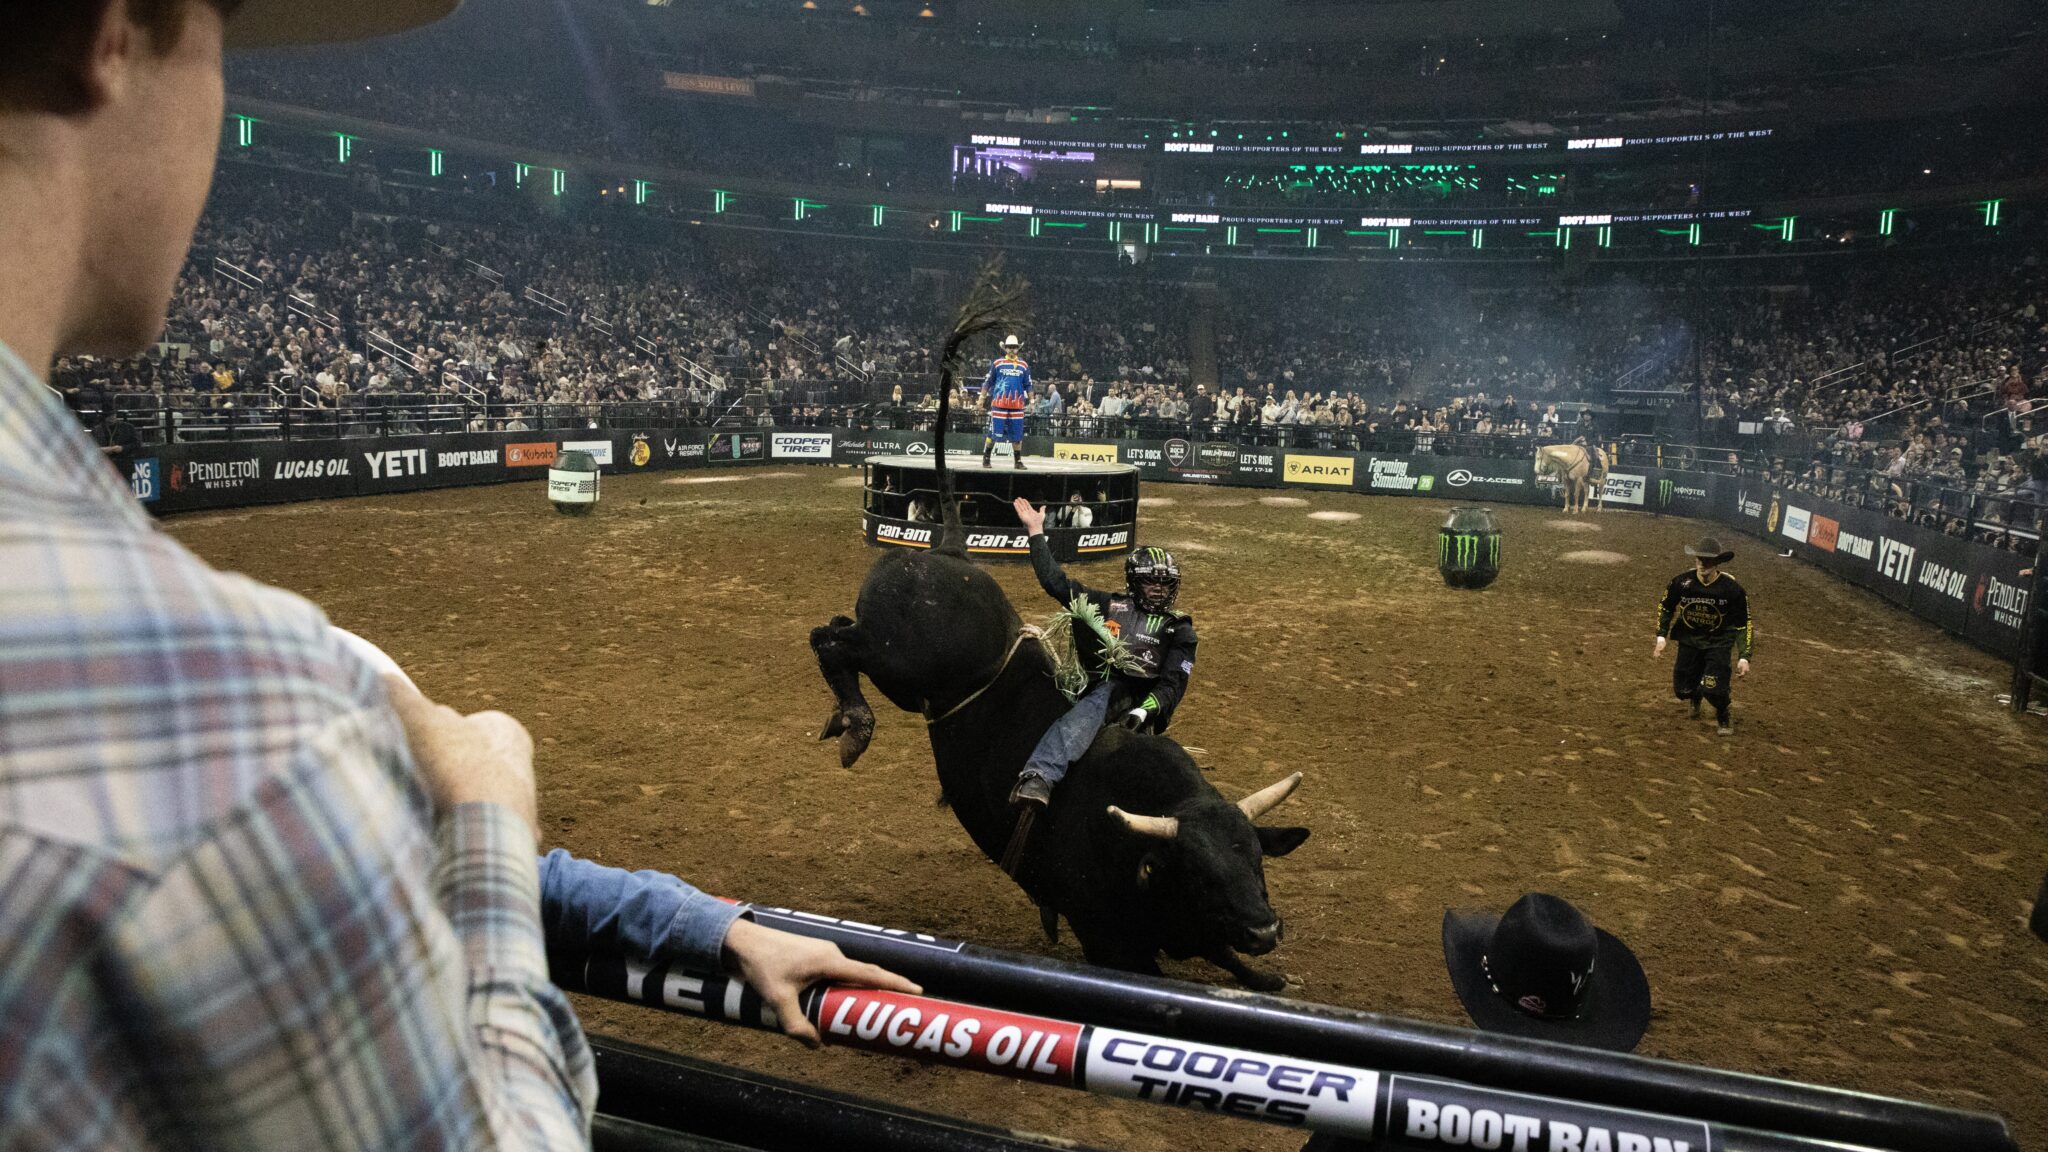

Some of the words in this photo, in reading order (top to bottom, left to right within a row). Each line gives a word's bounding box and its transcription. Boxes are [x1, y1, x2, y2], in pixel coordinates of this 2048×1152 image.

[971, 135, 996, 145] BOOT
[996, 136, 1021, 146] BARN
[1049, 140, 1096, 148] SUPPORTERS
[1567, 139, 1595, 150] BOOT
[1594, 137, 1623, 148] BARN
[1727, 131, 1745, 139] THE
[1748, 129, 1774, 137] WEST
[1164, 143, 1189, 152] BOOT
[1189, 143, 1214, 153] BARN
[1361, 145, 1387, 154] BOOT
[1386, 144, 1412, 154] BARN
[986, 203, 1009, 213] BOOT
[1009, 205, 1033, 215] BARN
[1060, 209, 1106, 217] SUPPORTERS
[1171, 213, 1196, 223] BOOT
[1195, 214, 1220, 224] BARN
[1361, 217, 1387, 227] BOOT
[1386, 218, 1412, 227] BARN
[1559, 216, 1585, 226] BOOT
[1585, 215, 1612, 225] BARN
[1641, 213, 1694, 221] SUPPORTERS
[775, 437, 831, 445] COOPER
[781, 445, 821, 453] TIRES
[837, 440, 865, 449] Michelob
[872, 442, 900, 450] ULTRA
[438, 451, 469, 468] BOOT
[469, 449, 499, 466] BARN
[1070, 453, 1114, 463] ARIAT
[1127, 449, 1144, 459] LET'S
[1144, 450, 1162, 460] ROCK
[1240, 454, 1258, 465] LET'S
[1258, 455, 1273, 466] RIDE
[132, 462, 151, 480] NG
[188, 458, 260, 483] PENDLETON
[274, 459, 325, 480] LUCAS
[326, 459, 350, 476] OIL
[364, 448, 428, 479] YETI
[1302, 465, 1350, 476] ARIAT
[1368, 457, 1409, 479] Farming
[205, 480, 244, 489] WHISKY
[1371, 472, 1418, 490] Simulator
[1421, 478, 1431, 487] 25
[1472, 476, 1523, 485] EZ-ACCESS
[1605, 478, 1642, 490] OPER
[132, 479, 152, 499] LD
[1602, 487, 1633, 498] IRES
[1673, 486, 1706, 497] MONSTER
[877, 523, 932, 542] can-am
[966, 533, 1048, 548] can-a
[1077, 530, 1128, 547] can-am
[1836, 530, 1855, 553] BOOT
[1851, 536, 1874, 560] BARN
[1877, 536, 1917, 585] YETI
[1918, 560, 1951, 593] LUCAS
[1947, 571, 1967, 600] OIL
[1986, 576, 2029, 615] PENDLET
[1994, 610, 2023, 630] WHISKY
[829, 995, 982, 1057] LUCAS
[985, 1024, 1062, 1075] OIL
[1101, 1037, 1357, 1102] COOPER
[1131, 1074, 1311, 1124] TIRES
[1405, 1098, 1541, 1151] BOOT
